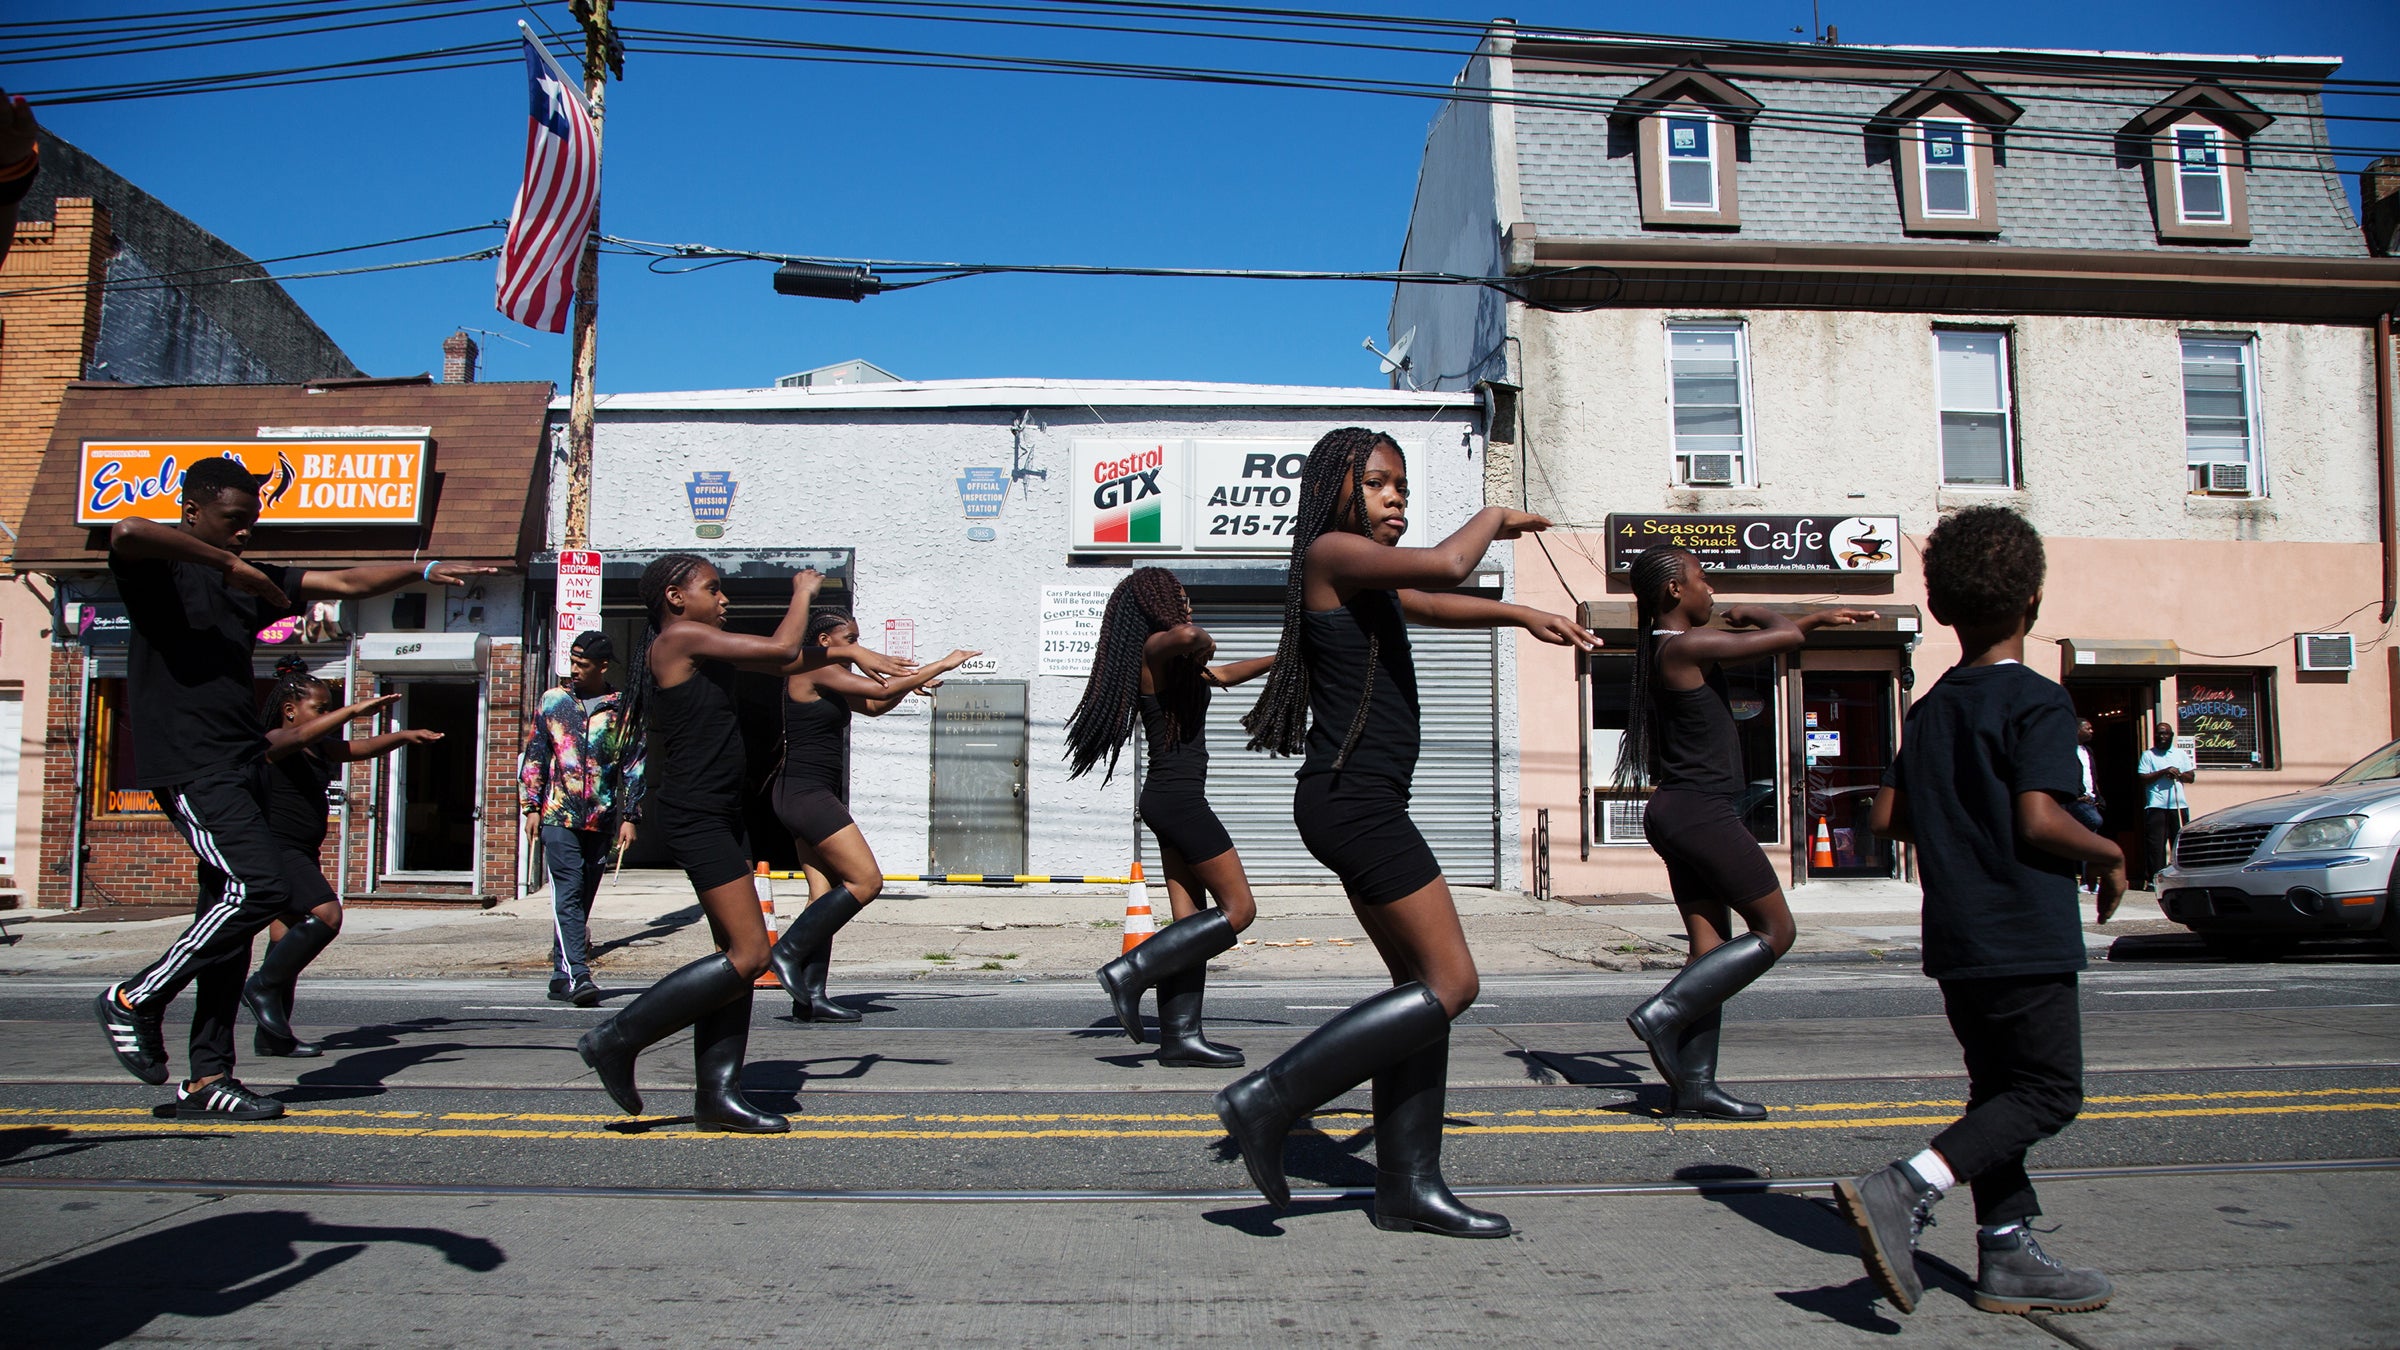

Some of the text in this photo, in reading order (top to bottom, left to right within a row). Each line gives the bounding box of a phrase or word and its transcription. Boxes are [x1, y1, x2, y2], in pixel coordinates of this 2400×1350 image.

[301, 453, 415, 479] BEAUTY
[1094, 444, 1163, 484] Castrol
[1242, 453, 1308, 479] RO
[695, 485, 728, 494] OFFICIAL
[967, 482, 1000, 491] OFFICIAL
[1094, 466, 1162, 509] GTX
[298, 483, 413, 508] LOUNGE
[694, 496, 728, 505] EMISSION
[962, 493, 1003, 502] INSPECTION
[1207, 486, 1292, 507] AUTO
[695, 507, 725, 516] STATION
[967, 504, 997, 513] STATION
[1209, 514, 1299, 535] 215-72
[1620, 519, 1737, 537] 4 Seasons
[1671, 534, 1738, 547] & Snack
[1743, 518, 1823, 560] Cafe
[572, 552, 588, 565] NO
[560, 564, 600, 575] STOPPING
[565, 578, 593, 587] ANY
[565, 589, 593, 599] TIME
[1092, 590, 1110, 600] Illeg
[1043, 608, 1085, 620] George
[560, 614, 574, 629] NO
[887, 620, 894, 629] NO
[1075, 620, 1094, 628] Inc.
[262, 629, 284, 640] $35
[395, 643, 422, 656] 6649
[965, 699, 990, 709] ALL
[2178, 701, 2248, 719] BARBERSHOP
[946, 711, 1006, 721] CUSTOMER
[2194, 715, 2235, 732] Hair
[2194, 732, 2237, 749] Salon
[107, 790, 164, 811] DOMINICA
